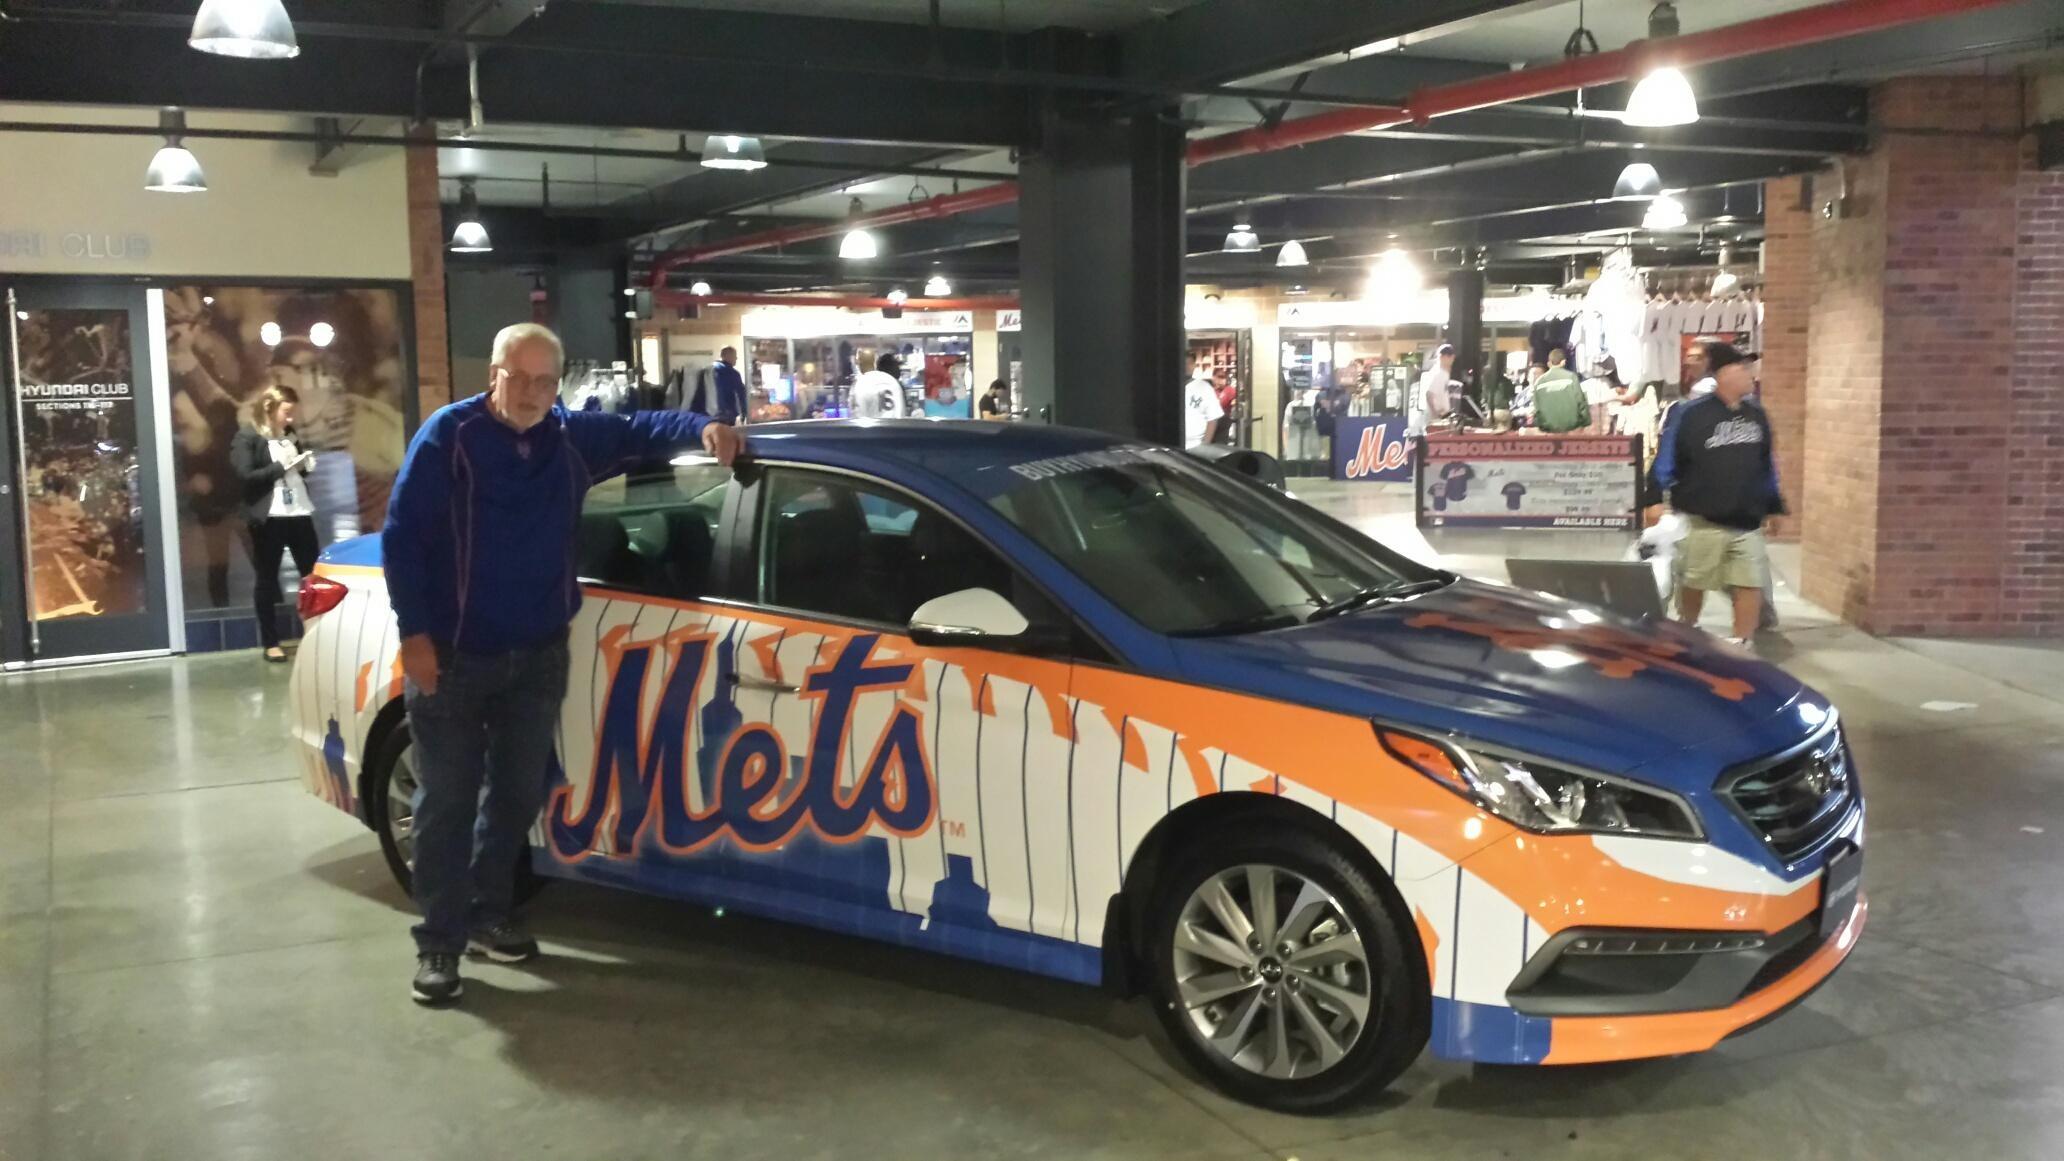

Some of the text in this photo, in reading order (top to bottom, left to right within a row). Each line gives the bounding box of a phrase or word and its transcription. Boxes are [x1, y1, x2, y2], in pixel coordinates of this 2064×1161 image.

[62, 231, 153, 259] CLUB
[999, 313, 1021, 329] Me
[21, 382, 130, 396] HYUNDAI CLUB
[35, 402, 82, 411] SECTIONS
[1428, 440, 1631, 457] PERSONALIZED JERSEYS
[1552, 517, 1602, 527] AVAILABLE
[546, 631, 938, 864] Mets
